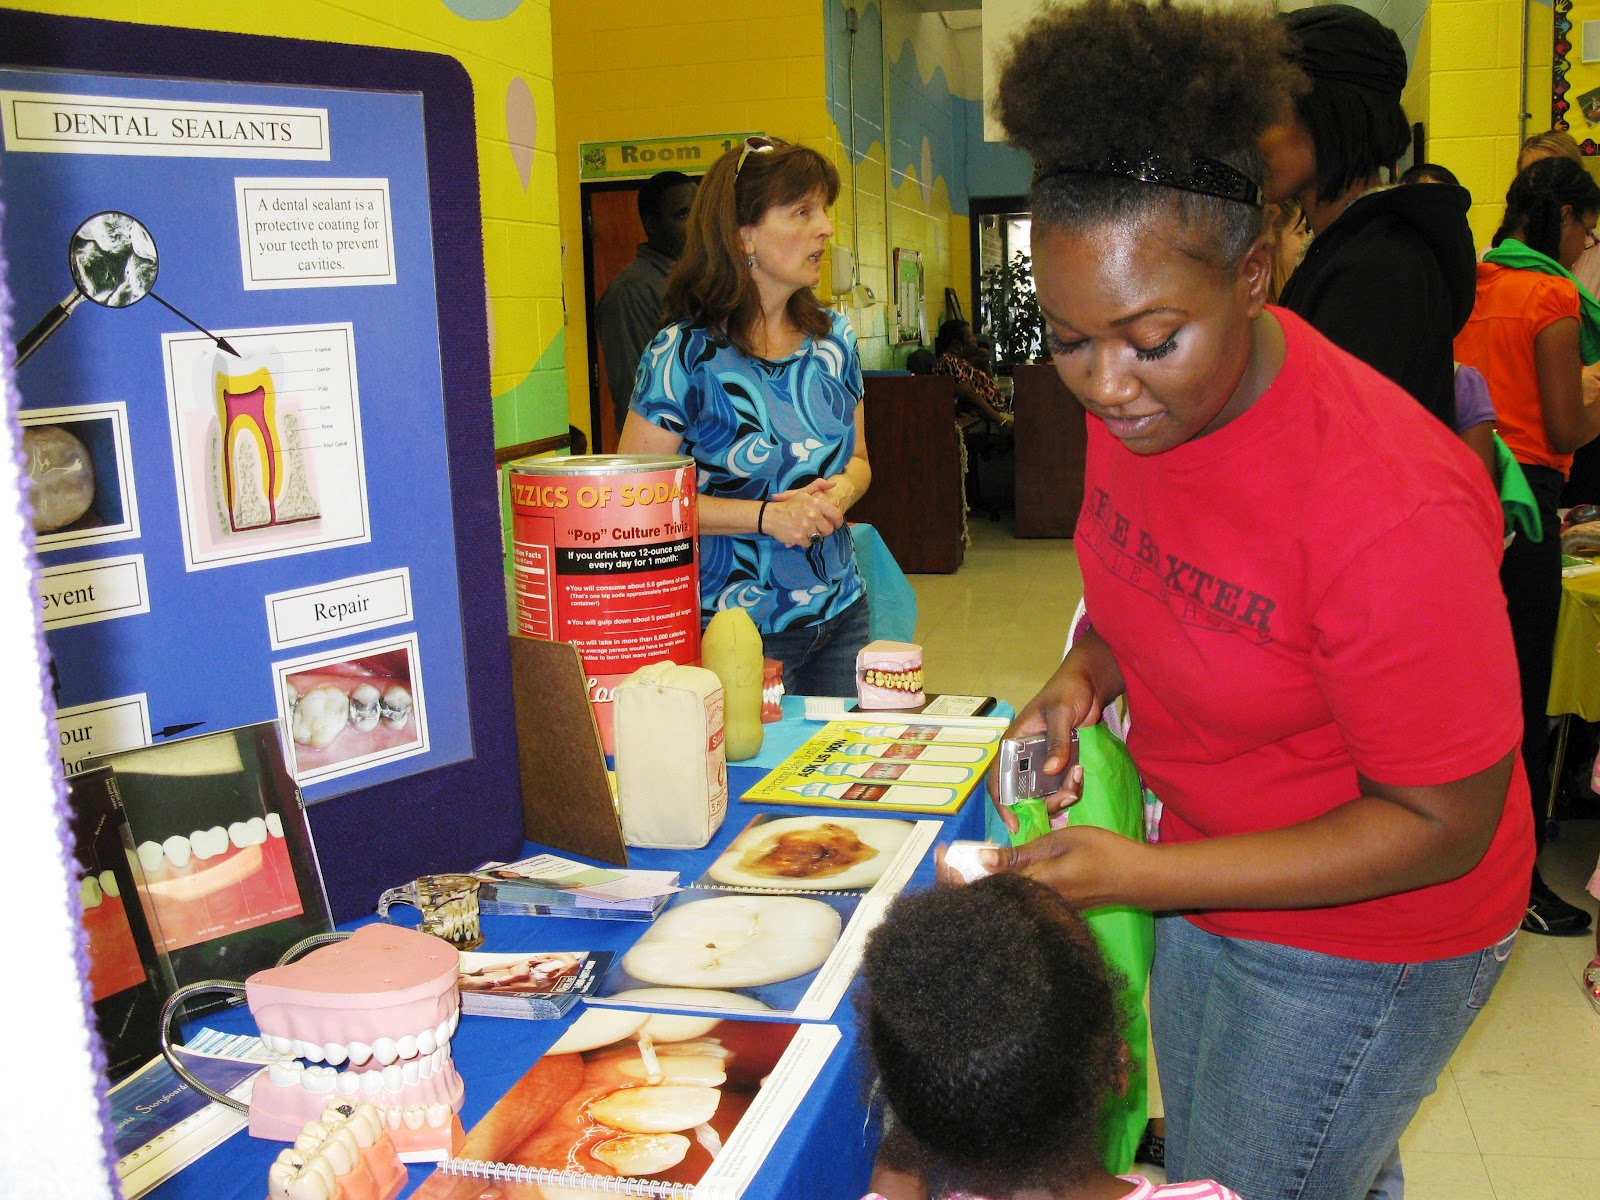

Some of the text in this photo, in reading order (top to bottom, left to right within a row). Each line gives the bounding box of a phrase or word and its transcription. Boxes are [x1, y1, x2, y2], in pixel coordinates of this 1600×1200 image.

[53, 112, 292, 142] DENTAL SEALANTS
[621, 145, 701, 163] Room
[258, 197, 374, 211] A dental sealant is a
[255, 216, 379, 235] protective coating for
[259, 238, 379, 256] your teeth to prevent
[298, 257, 345, 271] cavities.
[576, 486, 612, 509] OF
[620, 482, 682, 508] SODA
[612, 527, 660, 541] Culture
[664, 521, 689, 536] Trivia
[525, 550, 542, 559] Facts
[568, 551, 575, 560] If
[576, 552, 593, 562] you
[595, 550, 618, 560] drink
[620, 549, 636, 558] two
[638, 544, 673, 557] 12-ounce
[588, 561, 613, 571] every
[615, 559, 632, 570] day
[633, 558, 646, 567] for
[654, 554, 679, 565] month:
[596, 584, 626, 592] consume
[627, 582, 645, 590] about
[314, 595, 370, 622] Repair
[597, 619, 612, 627] gulp
[656, 612, 675, 622] pounds
[621, 637, 638, 645] more
[639, 635, 653, 643] than
[586, 647, 608, 655] average
[606, 653, 620, 661] burn
[797, 763, 822, 778] ASK
[812, 753, 832, 763] US
